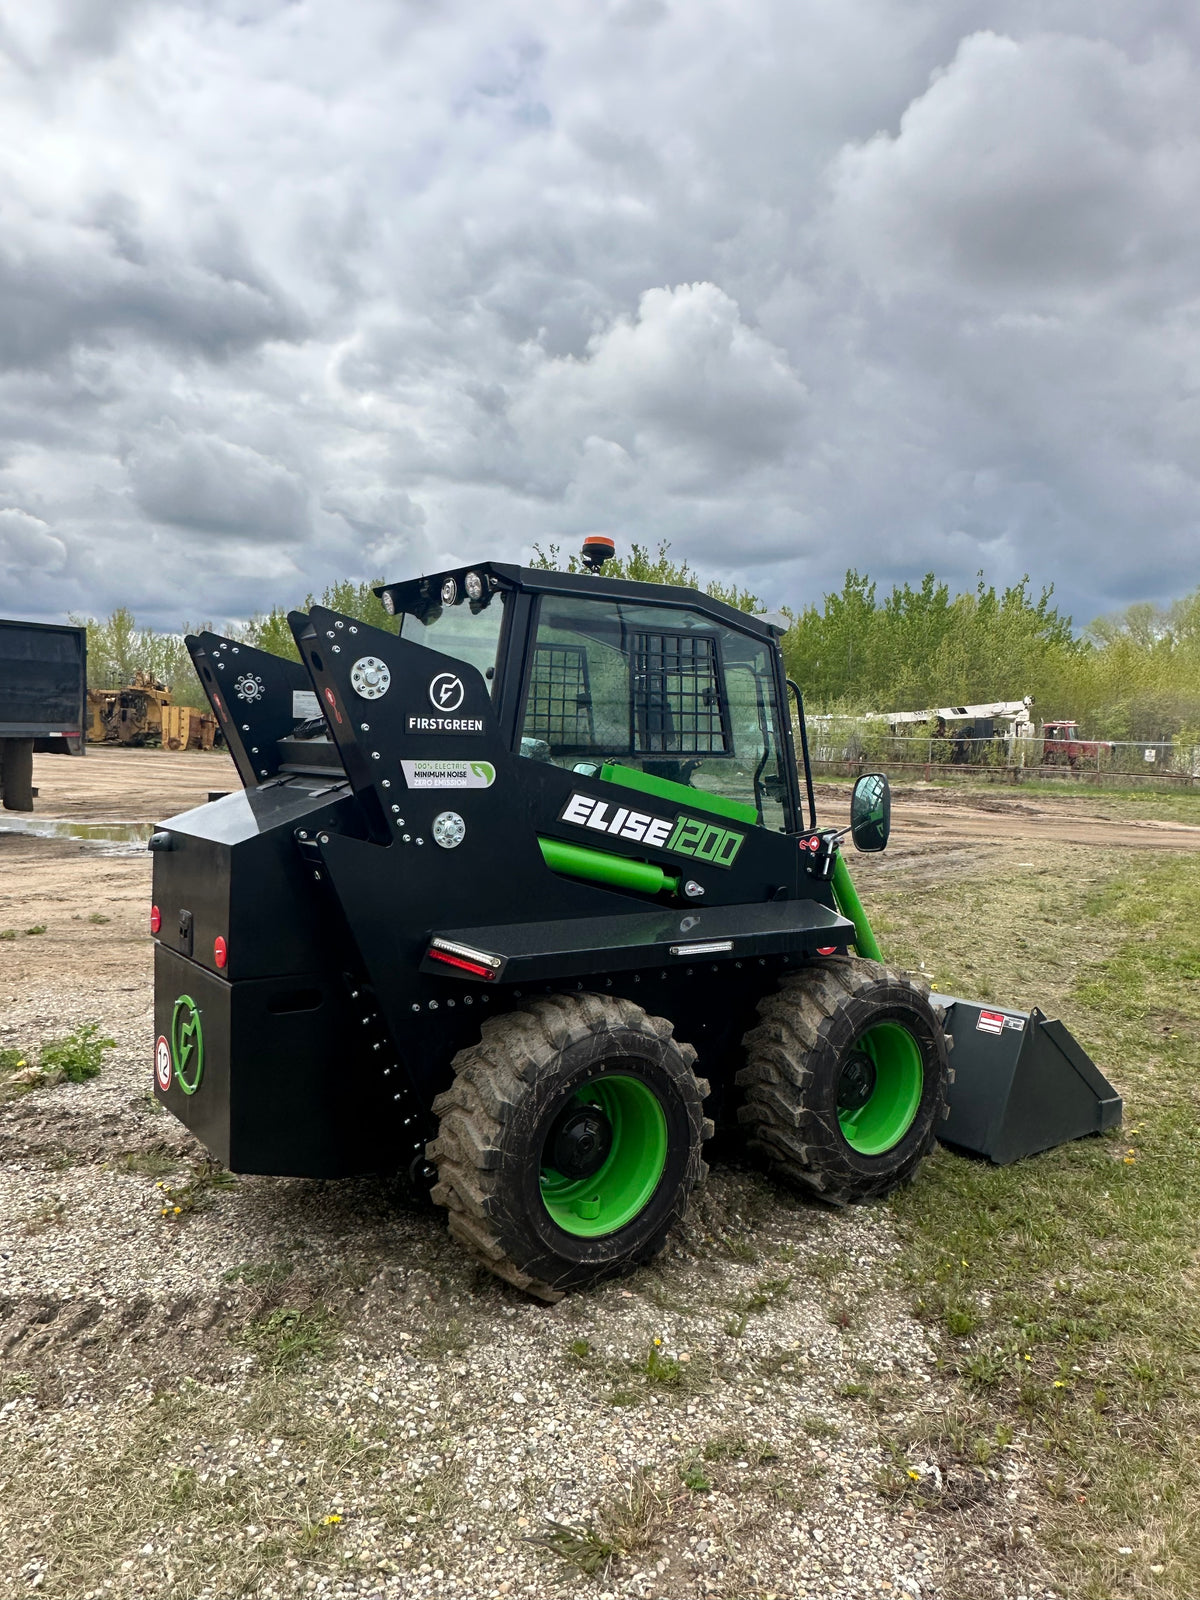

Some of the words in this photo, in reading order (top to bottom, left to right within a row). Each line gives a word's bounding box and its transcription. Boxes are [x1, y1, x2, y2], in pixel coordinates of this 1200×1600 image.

[409, 717, 483, 731] FIRSTGREEN
[414, 779, 433, 787] ZERO
[434, 779, 467, 787] EMISSION
[562, 794, 673, 848] ELISE
[668, 815, 745, 867] 1200
[158, 1049, 168, 1078] 12
